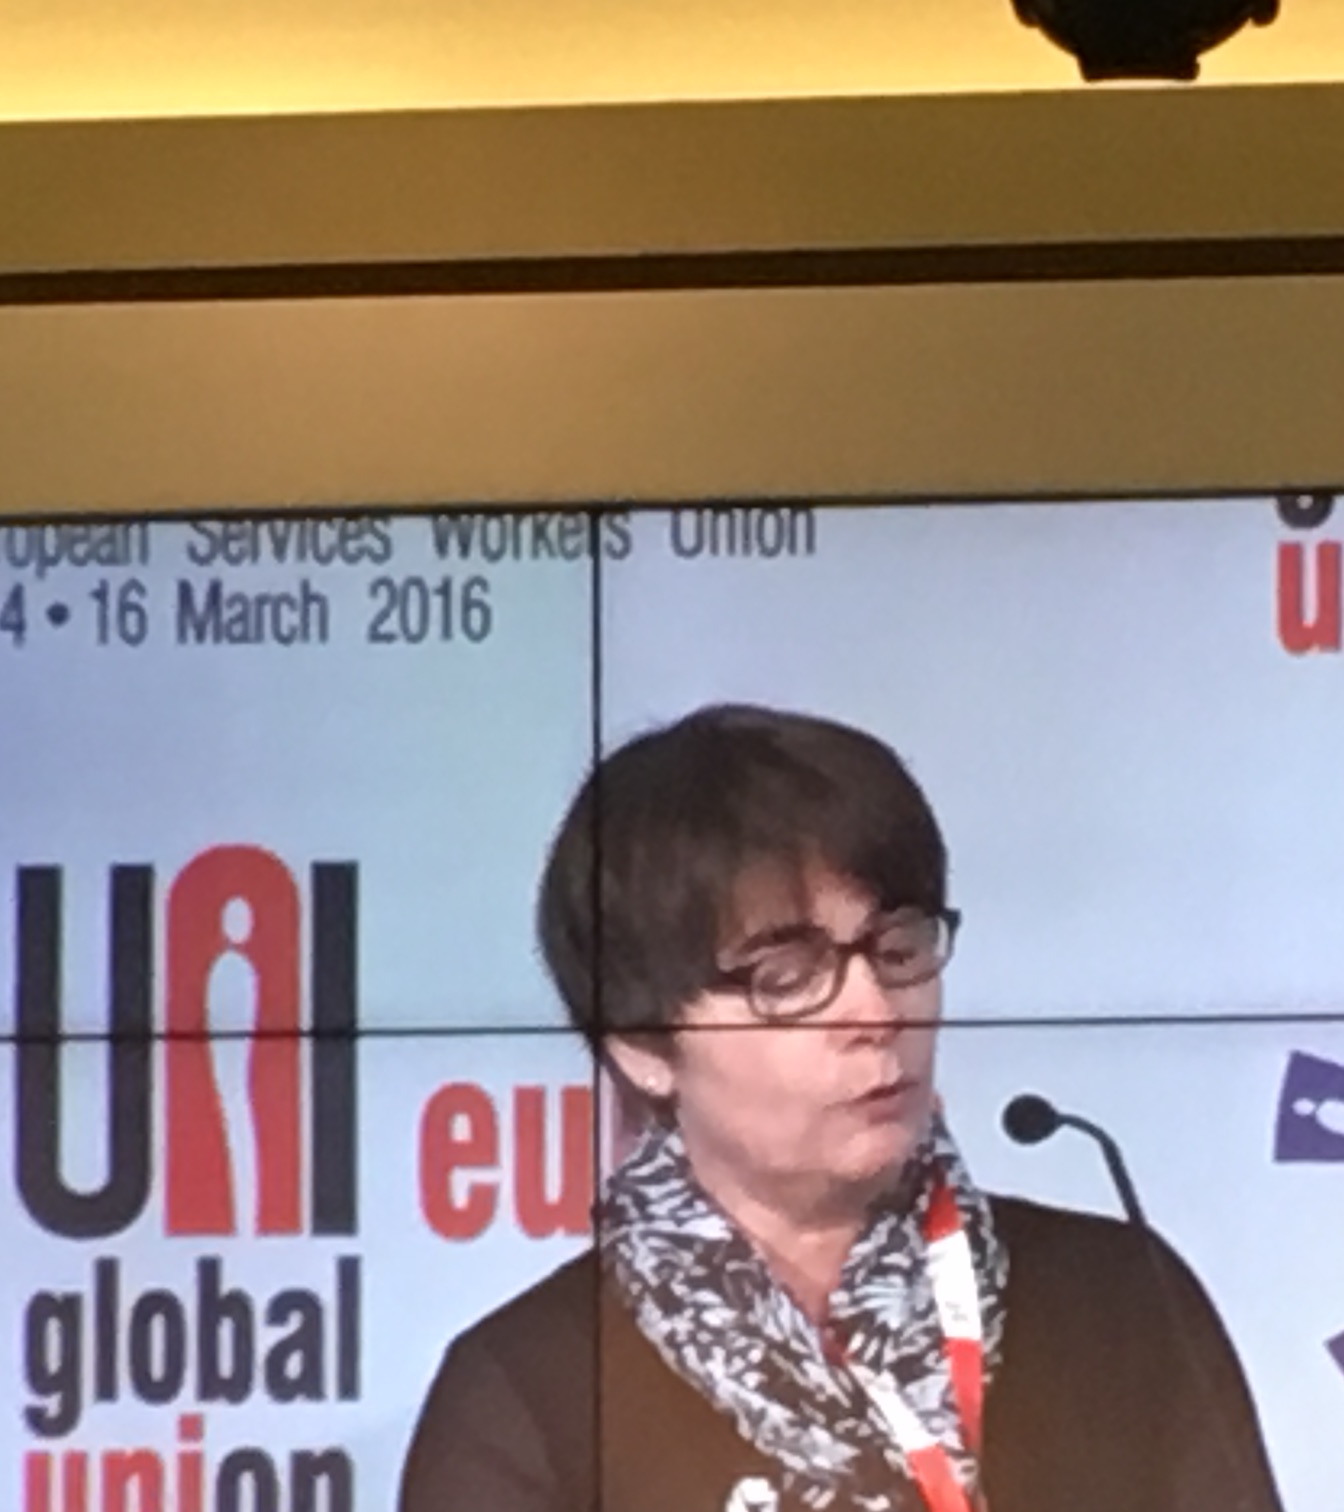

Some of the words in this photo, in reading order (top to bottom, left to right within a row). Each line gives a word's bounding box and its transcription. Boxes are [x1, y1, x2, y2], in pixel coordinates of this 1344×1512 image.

[90, 577, 148, 647] 16
[176, 577, 330, 646] March
[367, 575, 492, 644] 2016
[13, 842, 360, 1240] UNI
[21, 1256, 362, 1437] global
